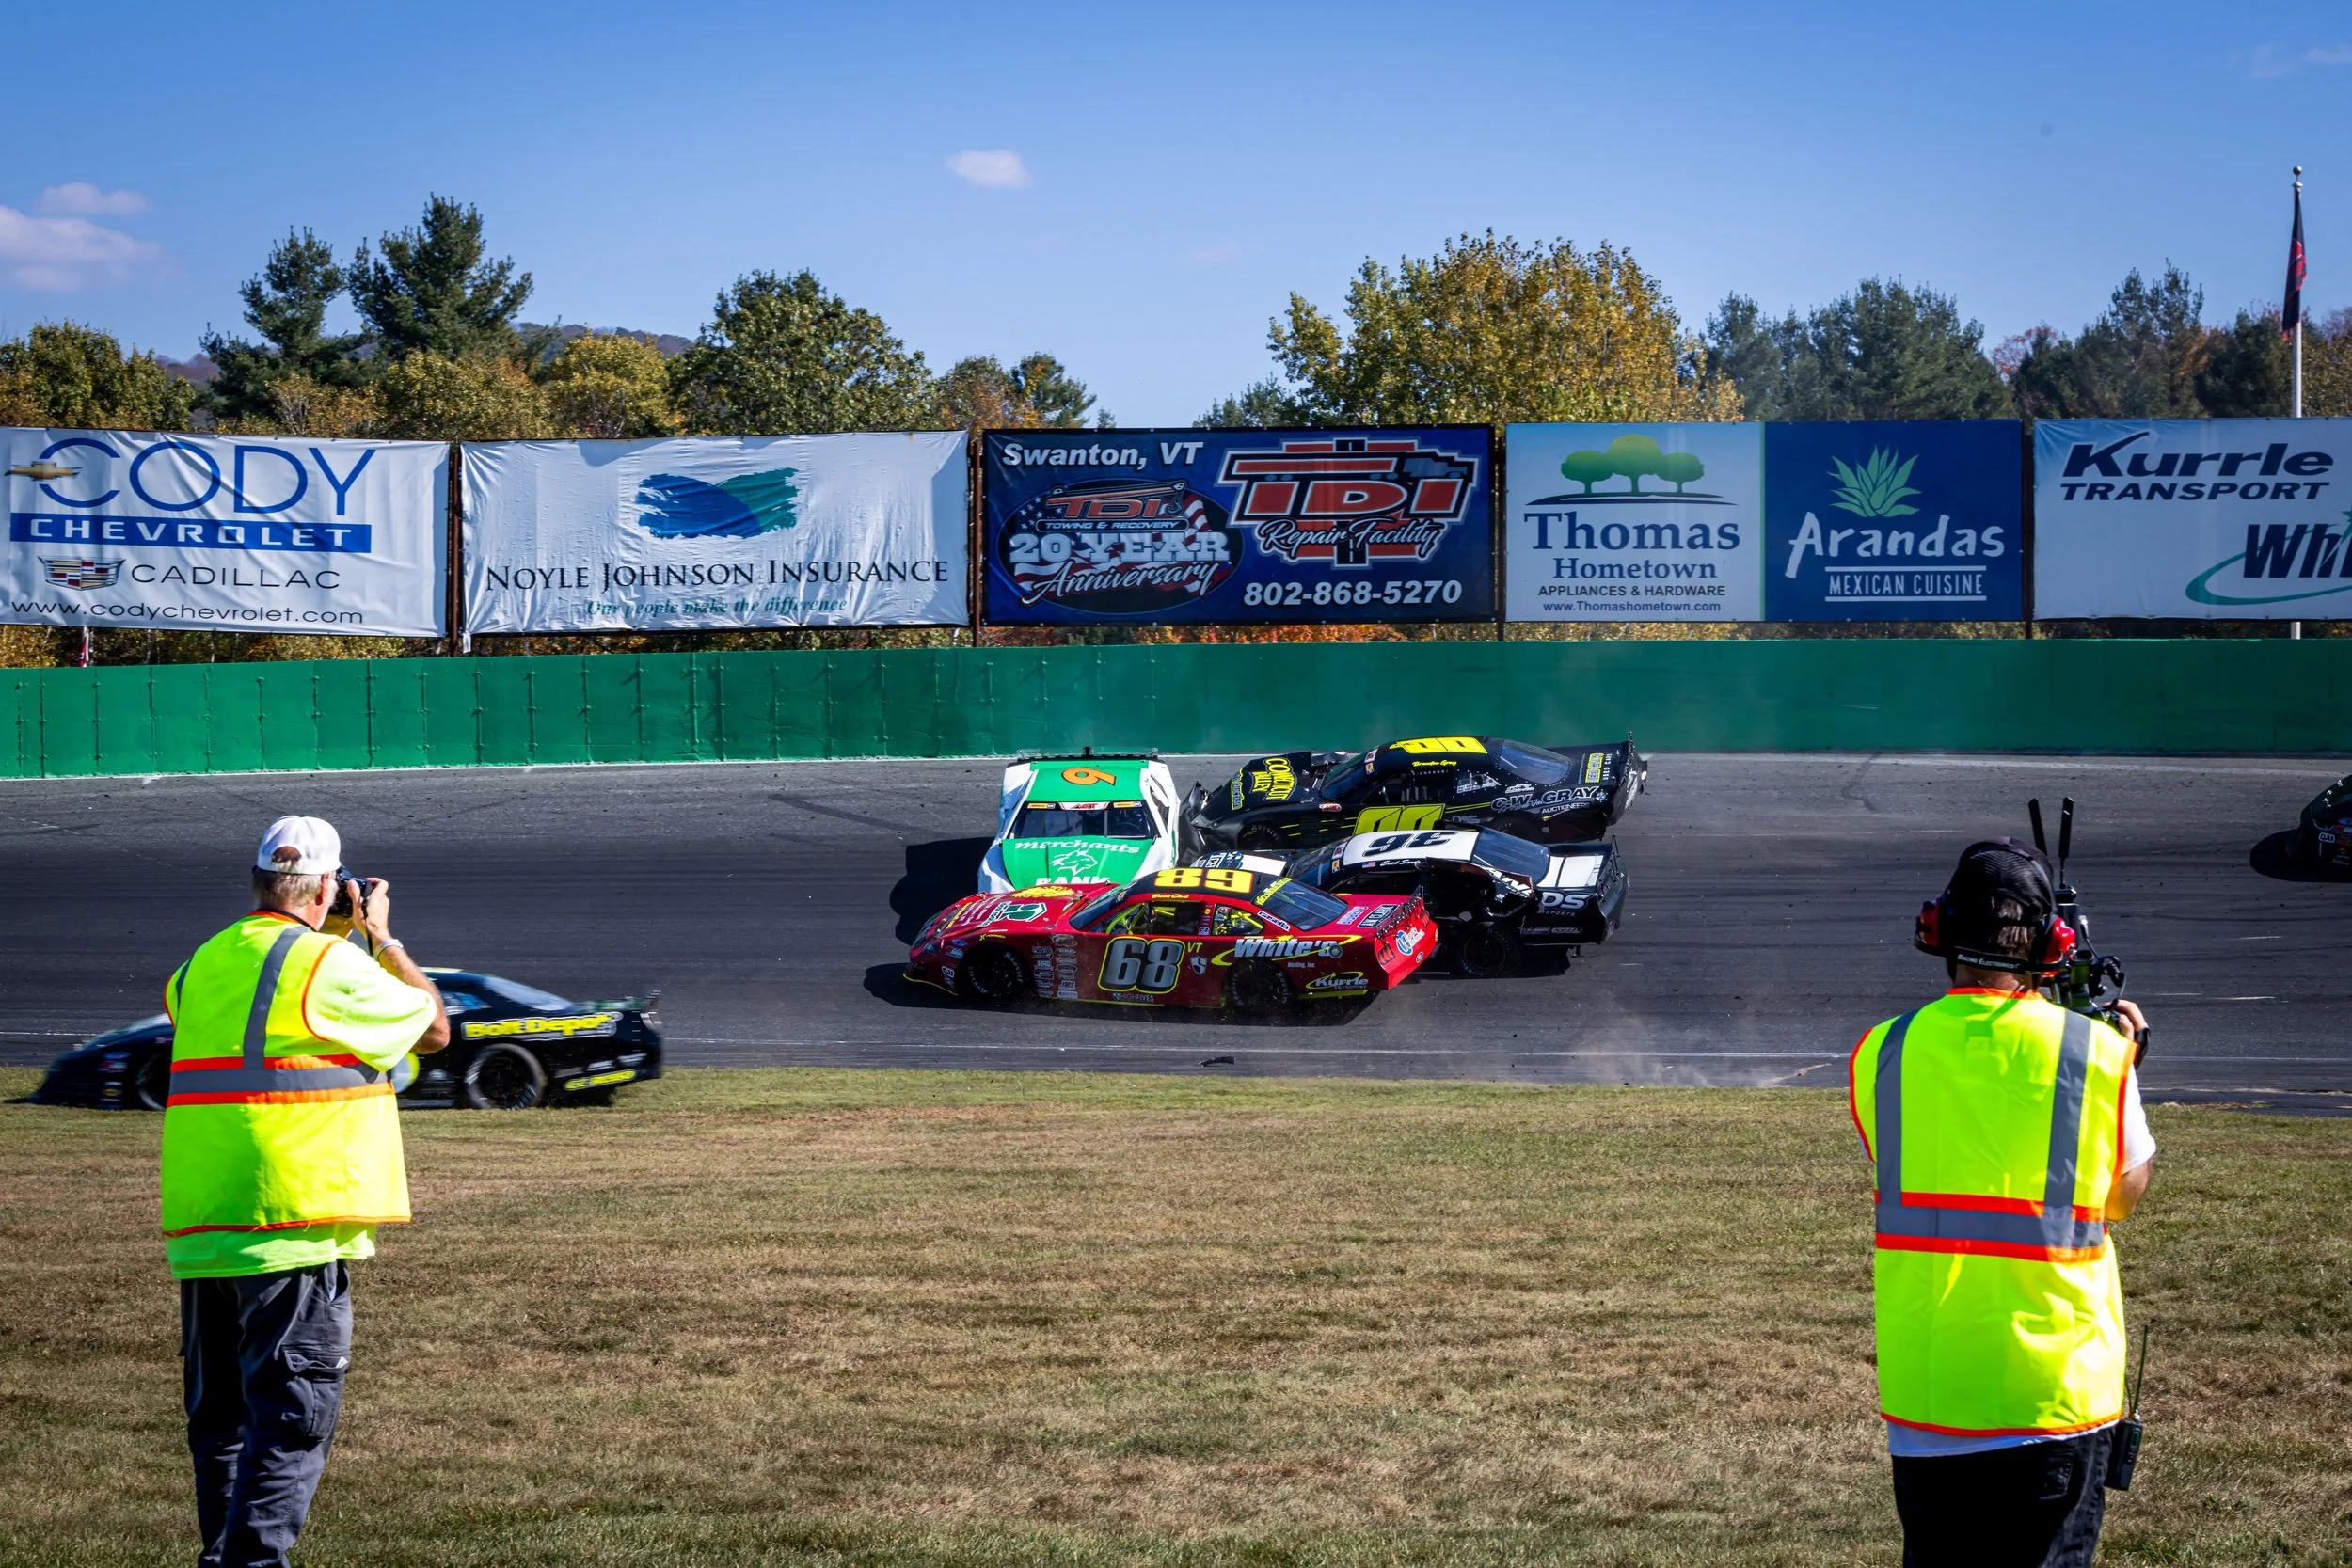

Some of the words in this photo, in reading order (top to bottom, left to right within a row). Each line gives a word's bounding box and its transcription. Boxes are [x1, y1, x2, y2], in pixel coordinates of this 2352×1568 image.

[1002, 443, 1147, 470] Swanton,
[1160, 442, 1204, 465] VT
[2062, 431, 2334, 477] Kurrle
[40, 437, 376, 516] CODY
[1224, 454, 1470, 519] TDI
[1046, 486, 1175, 518] TDI
[2060, 482, 2330, 500] TRANSPORT
[30, 518, 352, 547] CHEVROLET
[1260, 518, 1347, 559] Repair
[1349, 518, 1446, 559] Facility
[1524, 511, 1740, 550] Thomas
[1009, 533, 1072, 562] 20
[1074, 532, 1230, 562] YEAR
[1785, 512, 2005, 578] Arandas
[131, 564, 340, 589] CADILLAC
[486, 565, 589, 591] NOYLE
[601, 563, 753, 594] JOHNSON
[769, 560, 948, 584] INSURANCE
[1553, 557, 1717, 578] Hometown
[1021, 562, 1219, 605] Anniversary
[1243, 580, 1462, 606] 802-868-5270
[1538, 585, 1627, 596] APPLIANCES
[1631, 585, 1641, 596] &
[1645, 585, 1725, 596] HARDWARE
[1829, 575, 1905, 594] MEXICAN
[1914, 574, 1983, 594] CUISINE
[11, 600, 362, 624] www.codychevrolet.com
[587, 600, 620, 615] Our
[625, 599, 678, 617] people
[684, 597, 728, 613] make
[734, 597, 758, 612] the
[764, 596, 847, 615] difference
[1543, 601, 1721, 611] www.Thomashometown.com
[1541, 785, 1600, 802] GRAY
[1014, 839, 1140, 854] merchants
[1187, 942, 1203, 953] VT
[1234, 938, 1338, 958] White's
[1101, 937, 1184, 993] 68
[1316, 976, 1369, 987] Kurrle
